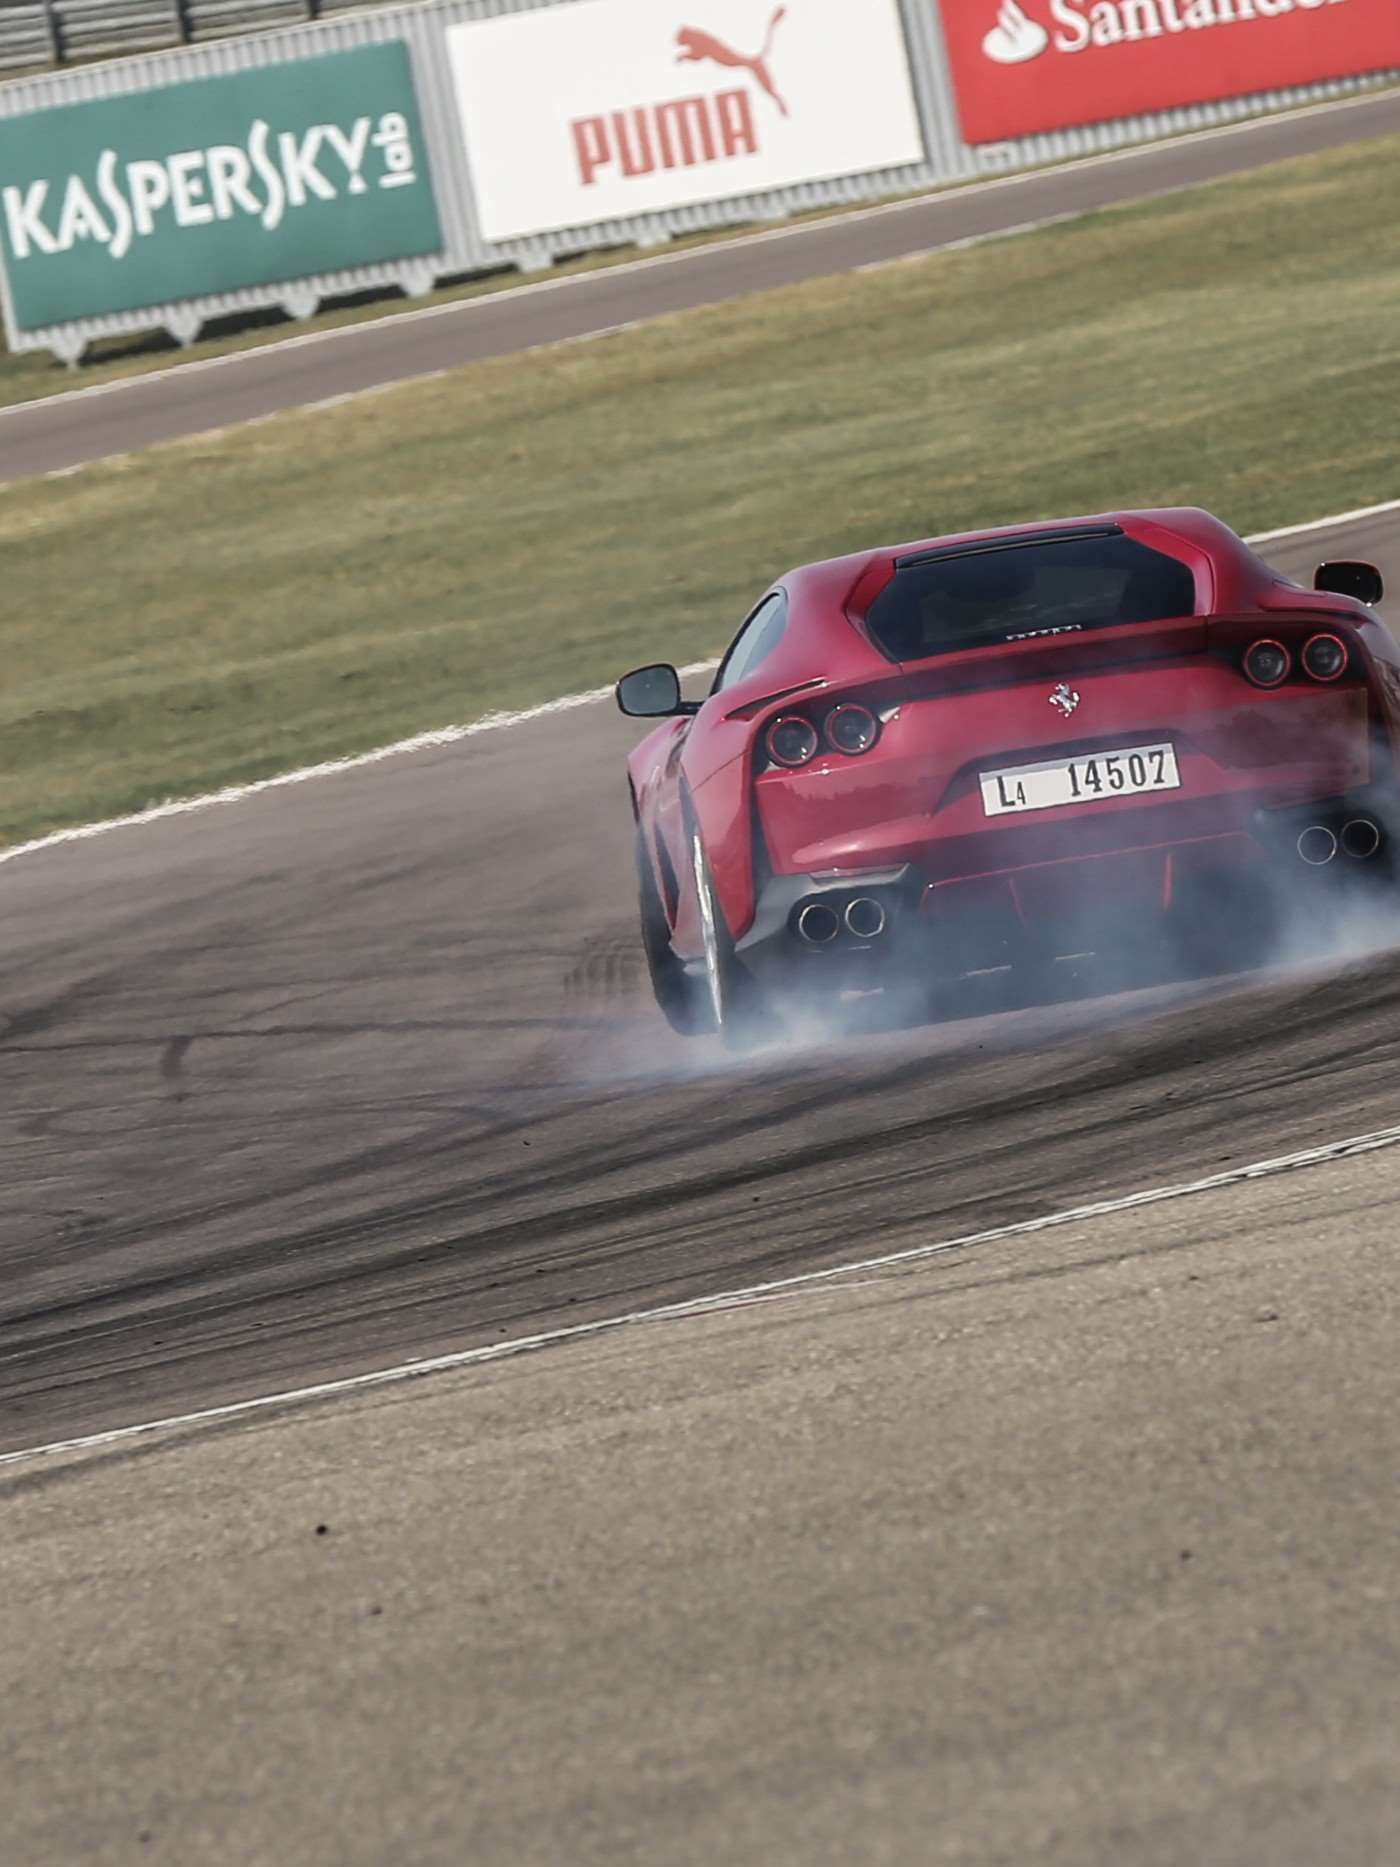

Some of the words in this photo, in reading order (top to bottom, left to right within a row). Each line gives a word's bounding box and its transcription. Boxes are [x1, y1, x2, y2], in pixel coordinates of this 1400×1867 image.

[1050, 0, 1346, 53] Santan
[572, 88, 758, 186] PUMA
[2, 116, 372, 260] KASPERSKY
[1067, 749, 1165, 797] 14507
